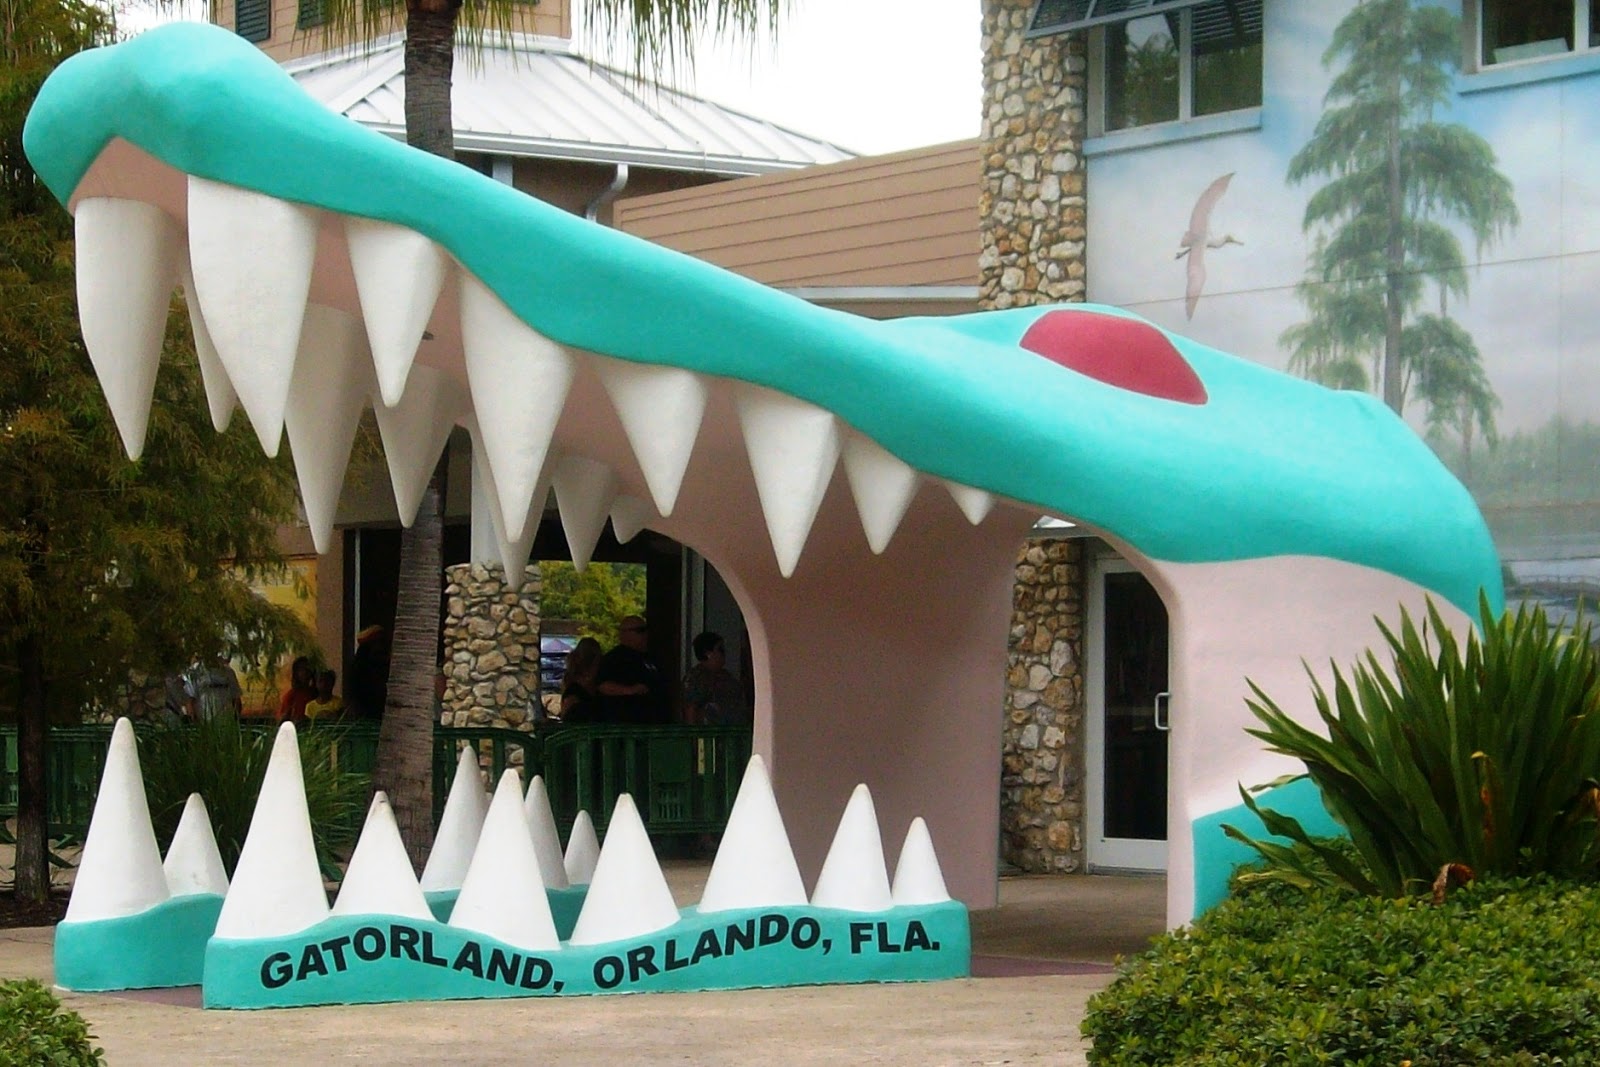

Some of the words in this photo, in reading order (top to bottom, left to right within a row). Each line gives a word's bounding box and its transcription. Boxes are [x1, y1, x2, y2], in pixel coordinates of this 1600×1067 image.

[260, 924, 564, 994] GATORLAND,
[593, 914, 832, 990] ORLANDO,
[850, 920, 940, 954] FLA.
